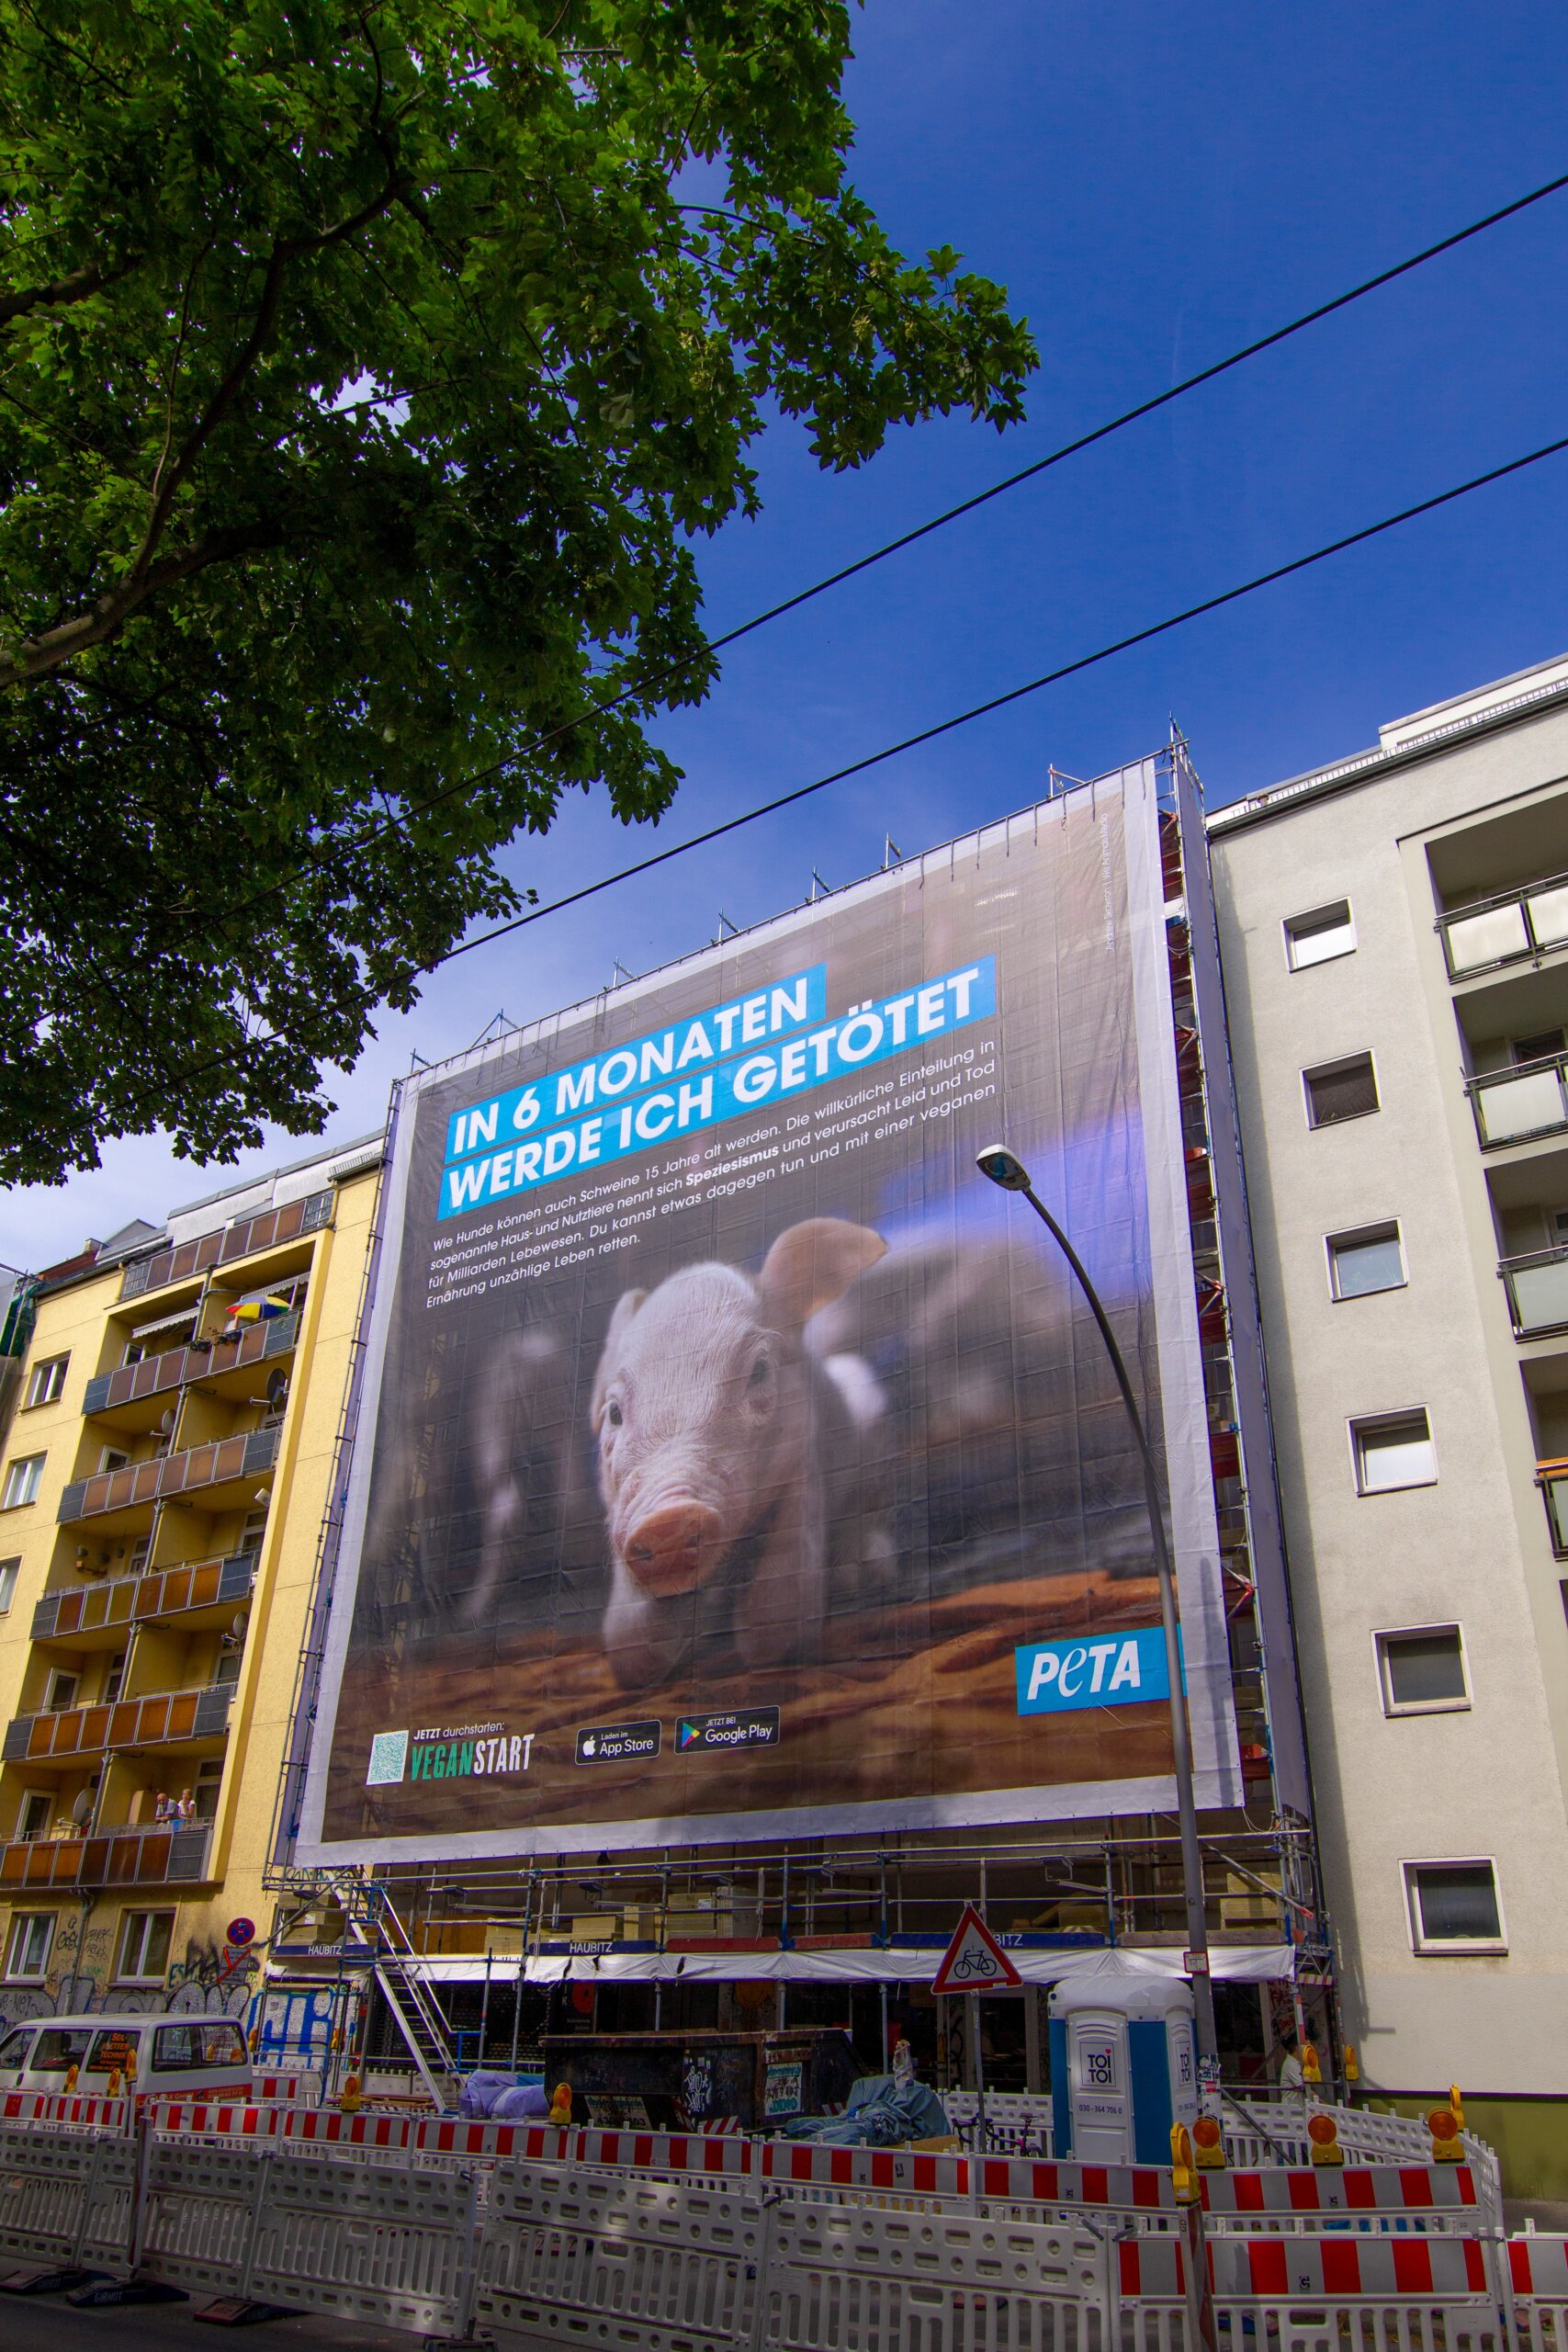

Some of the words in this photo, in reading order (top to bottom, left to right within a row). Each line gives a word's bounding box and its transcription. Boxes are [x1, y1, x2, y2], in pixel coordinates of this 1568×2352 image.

[454, 1102, 499, 1154] IN
[513, 1088, 540, 1129] 6
[557, 978, 807, 1114] MONATEN
[449, 1117, 603, 1208] WERDE
[619, 1076, 714, 1148] ICH
[732, 967, 980, 1102] GETÖTET
[434, 1238, 453, 1250] Wie
[457, 1224, 493, 1243] Hunde
[497, 1209, 540, 1230] können
[545, 1195, 576, 1214] auch
[581, 1175, 639, 1202] Schweine
[646, 1166, 659, 1180] 15
[663, 1154, 700, 1174] Jahre
[705, 1144, 721, 1159] alt
[726, 1126, 781, 1151] werden.
[787, 1115, 809, 1130] Die
[815, 1082, 894, 1119] willkürliche
[900, 1049, 974, 1086] Einteilung
[981, 1042, 994, 1054] in
[431, 1239, 498, 1271] sogenannte
[502, 1229, 535, 1247] Haus-
[536, 1218, 558, 1235] und
[562, 1204, 614, 1227] Nutztiere
[617, 1187, 653, 1209] nennt
[657, 1179, 682, 1195] sich
[686, 1147, 779, 1186] Speziesismus
[784, 1132, 810, 1152] und
[815, 1102, 890, 1140] verursacht
[896, 1087, 925, 1110] Leid
[931, 1073, 960, 1095] und
[965, 1059, 994, 1080] Tod
[428, 1274, 445, 1289] für
[446, 1254, 506, 1283] Milliarden
[510, 1232, 584, 1262] Lebewesen.
[590, 1225, 607, 1238] Du
[613, 1205, 656, 1230] kannst
[660, 1192, 702, 1214] etwas
[706, 1169, 774, 1198] dagegen
[781, 1159, 804, 1174] tun
[811, 1142, 839, 1163] und
[846, 1132, 869, 1150] mit
[874, 1115, 914, 1138] einer
[920, 1085, 995, 1120] veganen
[426, 1280, 487, 1308] Ernährung
[491, 1261, 550, 1288] unzählige
[555, 1246, 594, 1267] Leben
[599, 1234, 640, 1254] retten.
[413, 1728, 441, 1741] JETZT
[443, 1722, 504, 1738] durchstarten:
[706, 1718, 725, 1727] JETZT
[726, 1716, 737, 1725] BEI
[601, 1732, 619, 1740] Laden
[705, 1726, 747, 1744] Google
[749, 1724, 773, 1740] Play
[600, 1742, 622, 1757] App
[625, 1737, 654, 1752] Store
[308, 1945, 342, 1955] HAUBITZ
[570, 1941, 613, 1953] HAUBITZ
[993, 1934, 1023, 1946] BITZ
[1089, 2069, 1111, 2083] TOI
